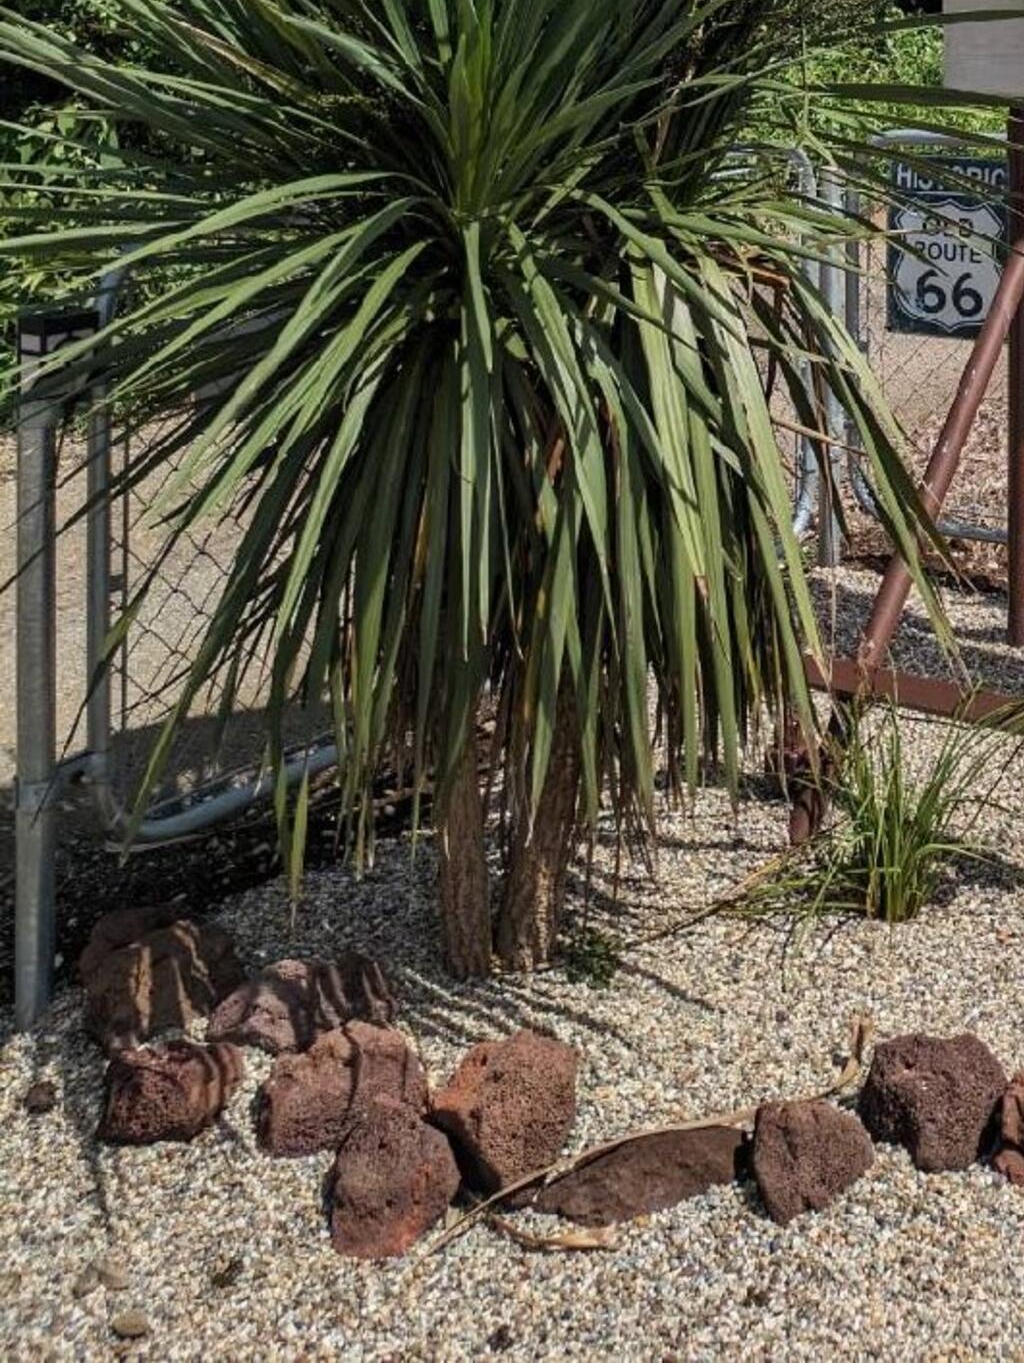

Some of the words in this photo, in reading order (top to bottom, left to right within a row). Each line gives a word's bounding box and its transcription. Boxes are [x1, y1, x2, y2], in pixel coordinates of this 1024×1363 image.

[896, 162, 1007, 190] HIRIC
[914, 240, 983, 264] ROUTE
[916, 269, 984, 318] 66
